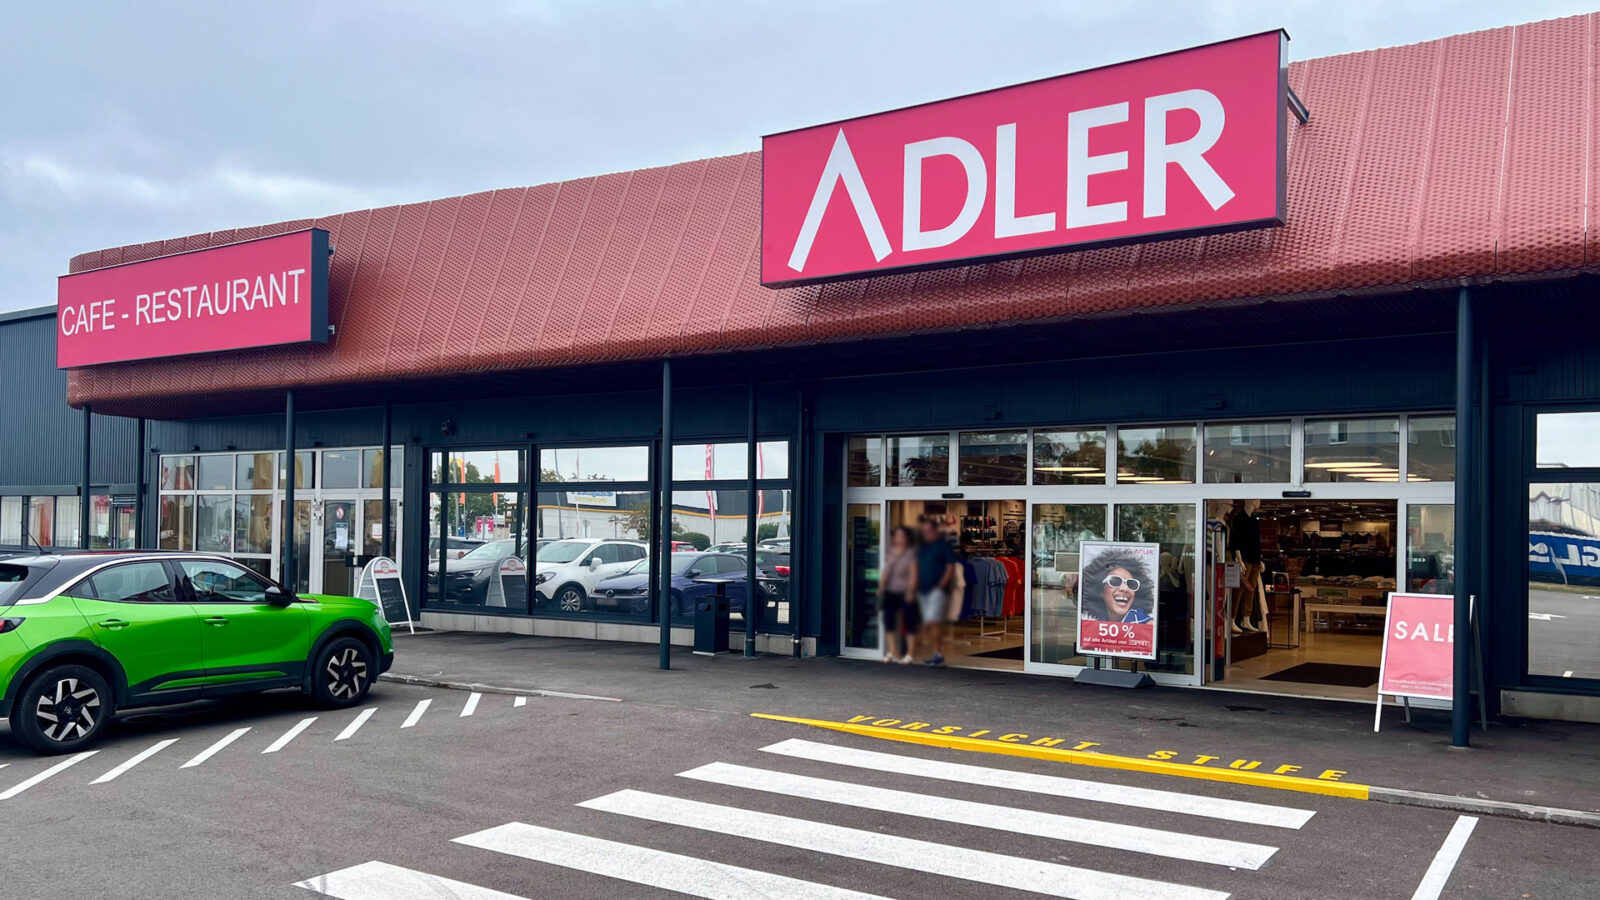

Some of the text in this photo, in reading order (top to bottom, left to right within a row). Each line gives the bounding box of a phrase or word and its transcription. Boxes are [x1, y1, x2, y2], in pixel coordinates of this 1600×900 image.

[787, 88, 1236, 273] ADLER
[61, 299, 116, 336] CAFE
[136, 269, 305, 326] RESTAURANT
[1098, 623, 1135, 639] 50 %
[847, 714, 1348, 782] VORSICHT STUFE
